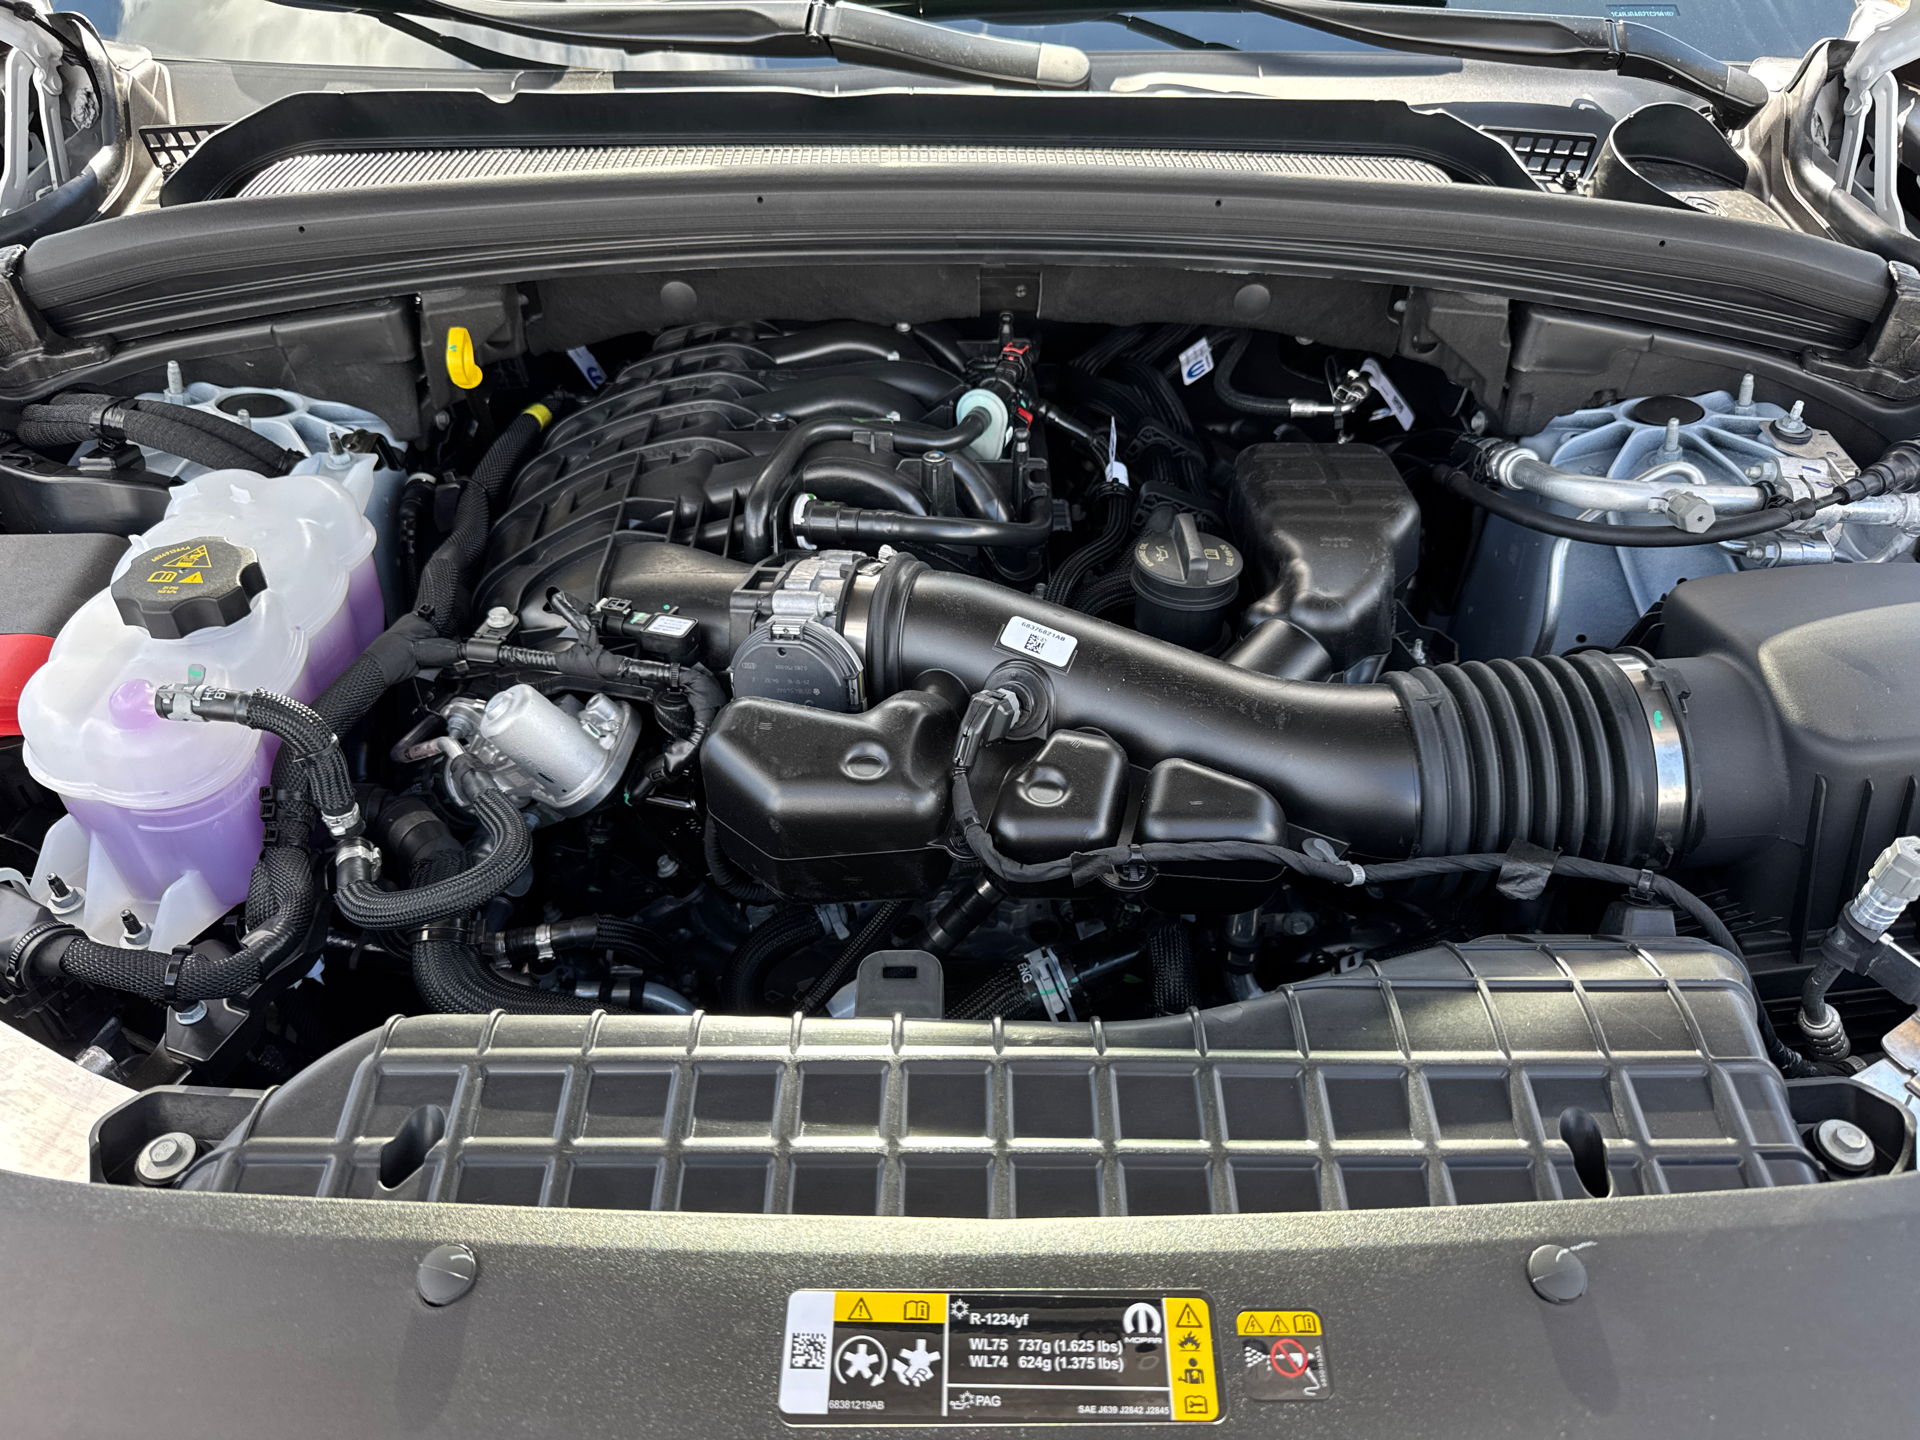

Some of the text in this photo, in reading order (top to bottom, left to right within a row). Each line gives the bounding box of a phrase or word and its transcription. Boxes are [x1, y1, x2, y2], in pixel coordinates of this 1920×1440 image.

[1225, 556, 1235, 567] SAE
[1021, 621, 1066, 642] 68376821AB
[1017, 962, 1033, 984] ENG
[969, 1313, 1029, 1328] R-1234yf
[1124, 1336, 1163, 1344] MOPAR
[968, 1338, 1124, 1356] WL75 737g (1.625 lbs)
[968, 1355, 1125, 1373] WL74 624g (1.375 lbs)
[829, 1400, 885, 1410] 68381219AB
[975, 1395, 1002, 1407] PAG
[1077, 1405, 1170, 1415] SAE J639 J2842 J2845
